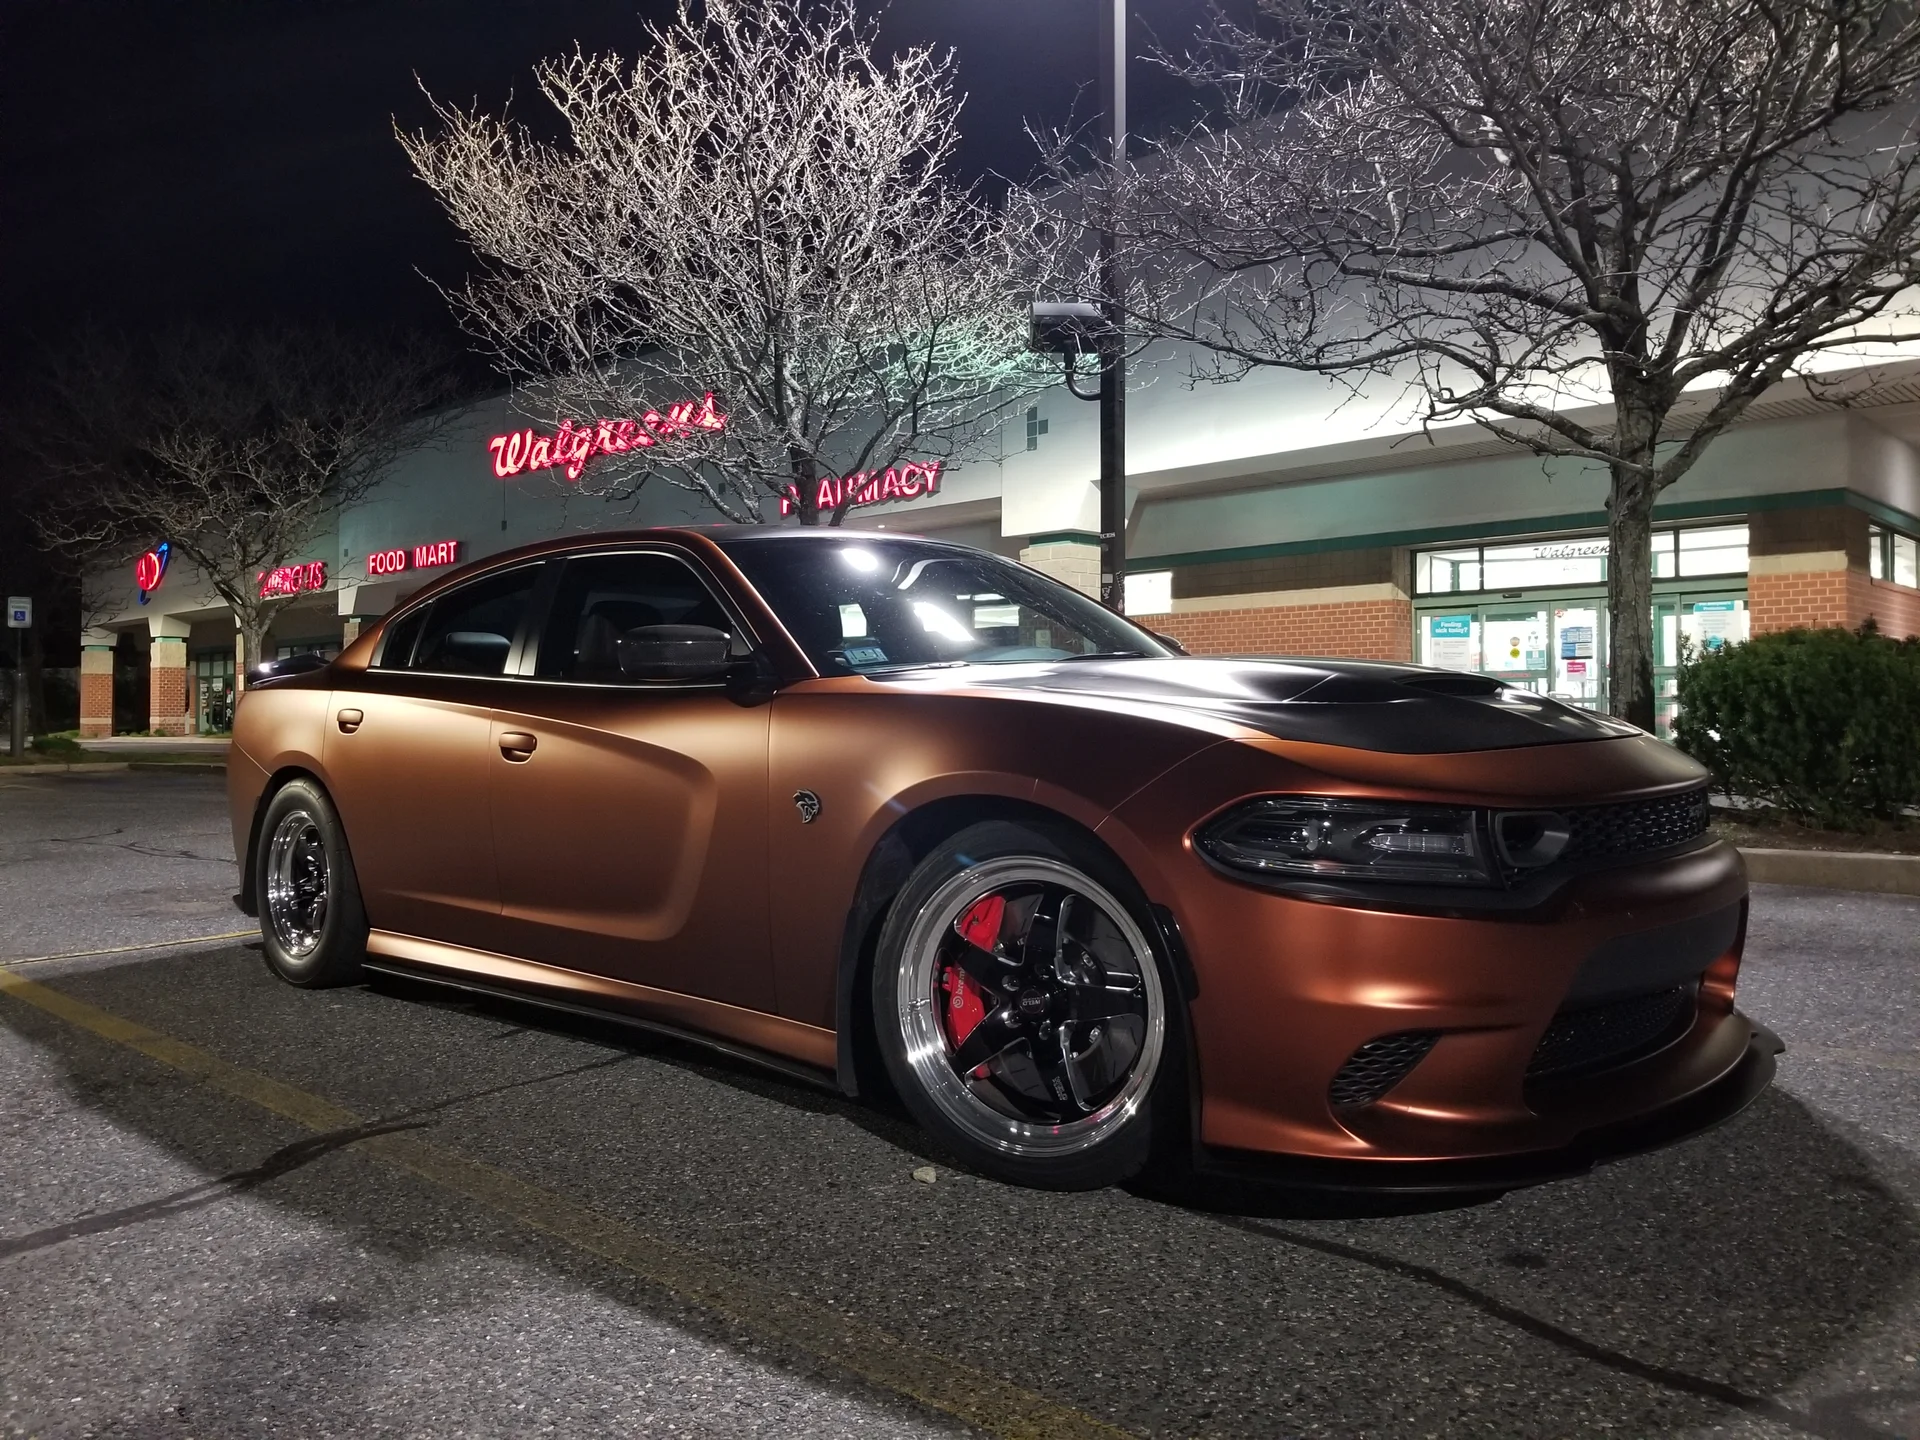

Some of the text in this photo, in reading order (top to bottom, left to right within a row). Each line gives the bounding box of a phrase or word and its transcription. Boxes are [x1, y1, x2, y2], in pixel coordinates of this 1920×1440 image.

[368, 540, 457, 575] FOOD MART
[1532, 544, 1609, 560] Walgreen
